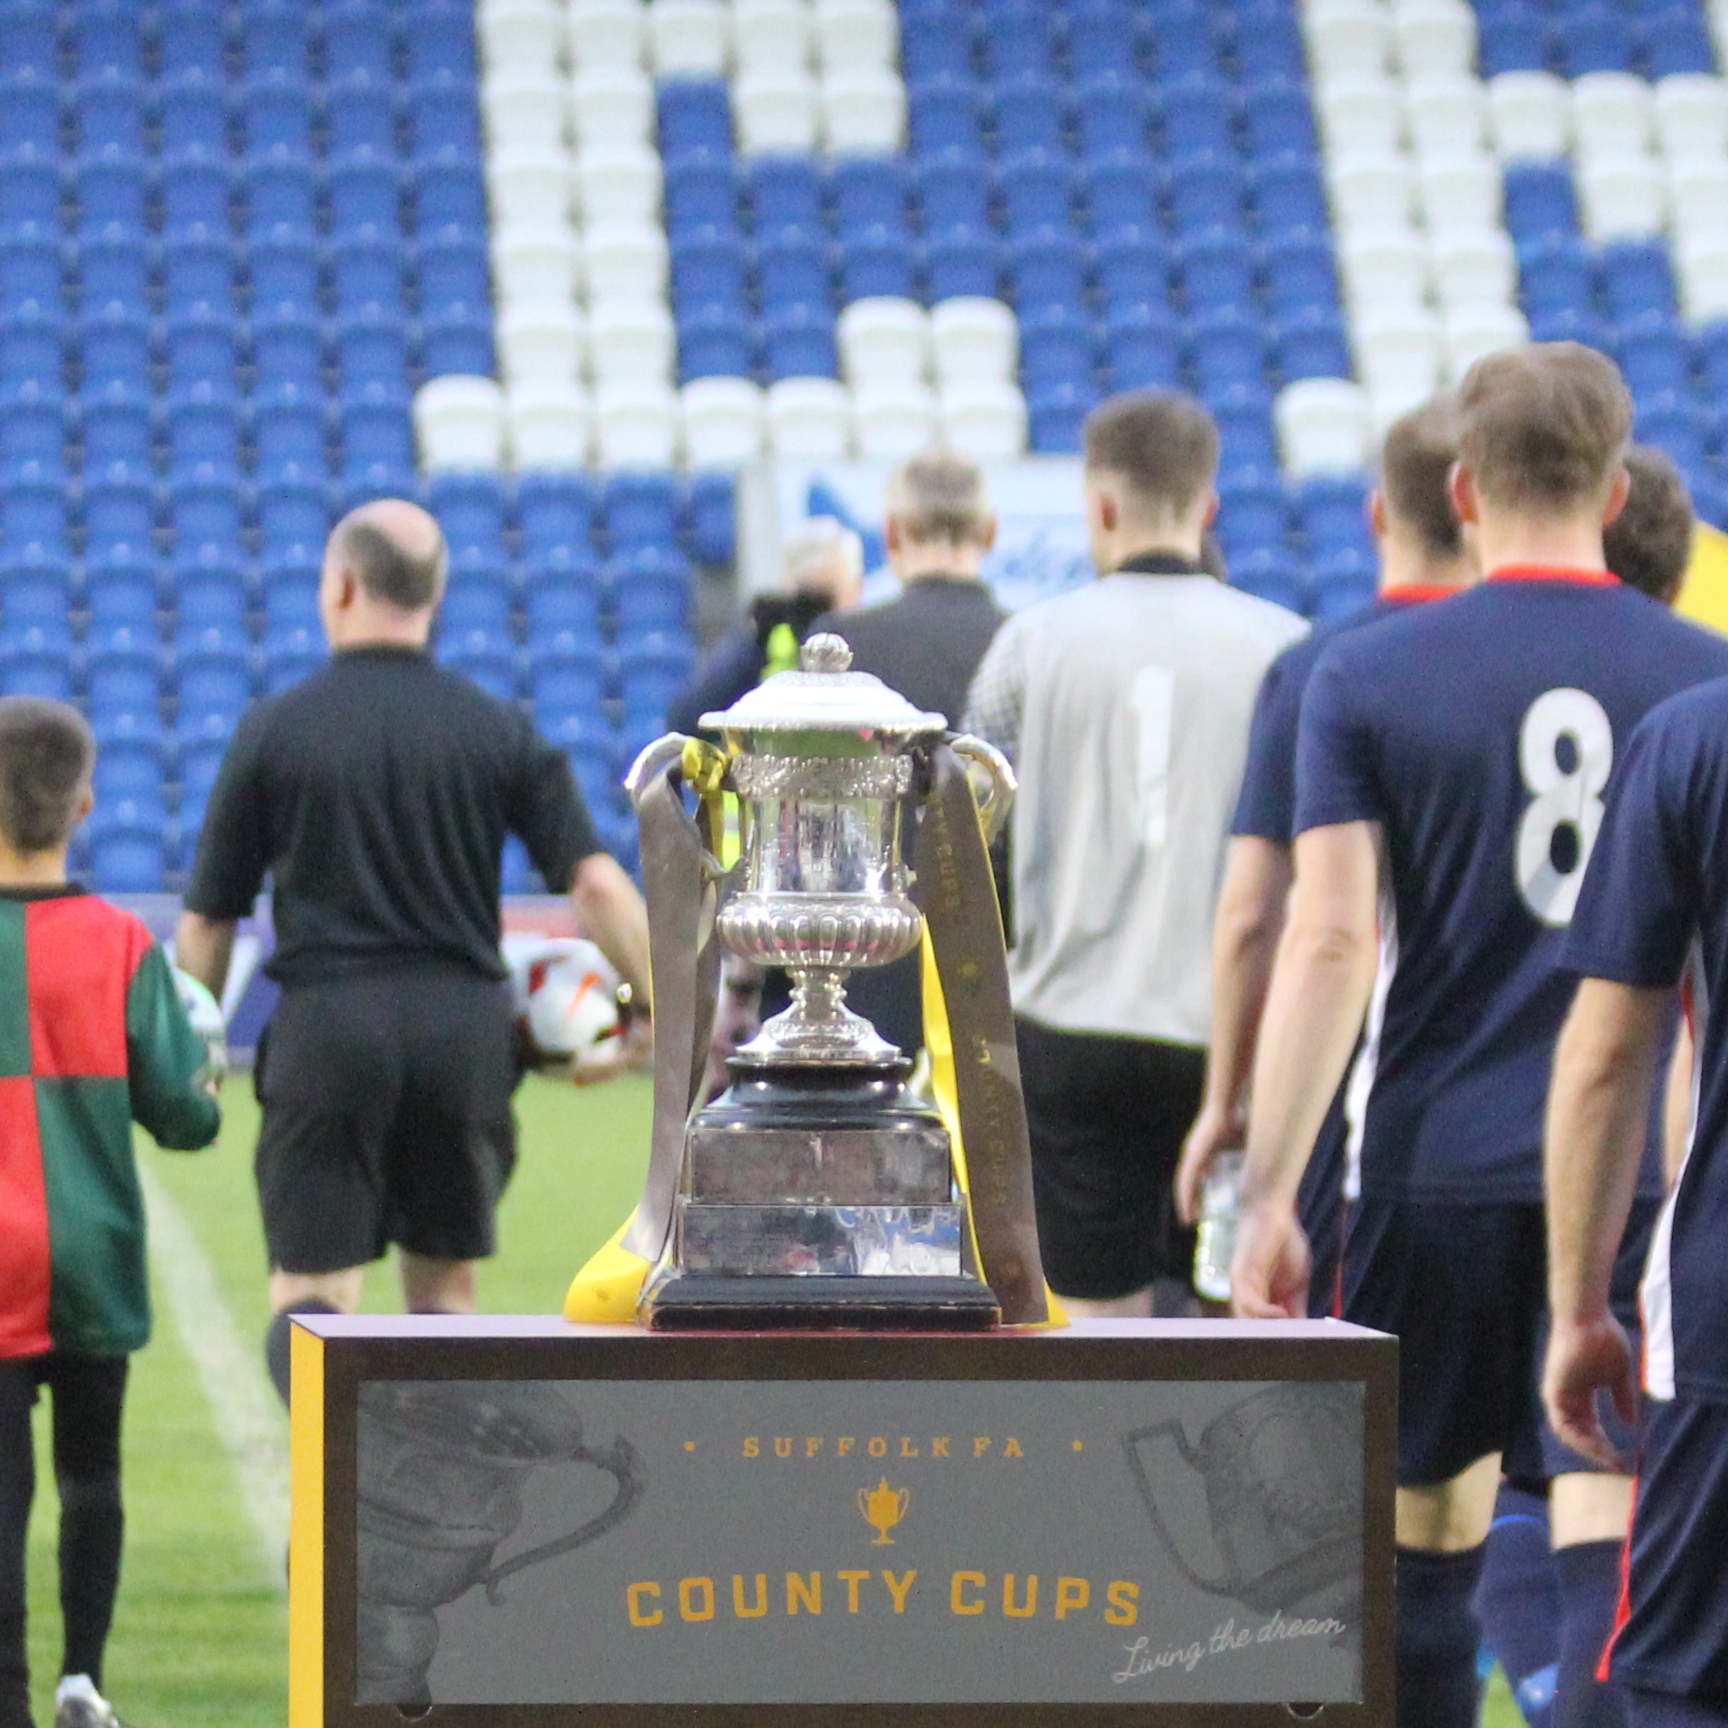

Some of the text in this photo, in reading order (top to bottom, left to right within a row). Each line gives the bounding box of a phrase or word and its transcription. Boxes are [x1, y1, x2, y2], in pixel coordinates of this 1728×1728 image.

[1132, 664, 1174, 844] 1
[1515, 686, 1614, 927] 8
[742, 1437, 1025, 1458] SUFFOLK FA
[626, 1569, 1140, 1627] COUNTY CUPS
[1111, 1599, 1347, 1684] Living the dream
